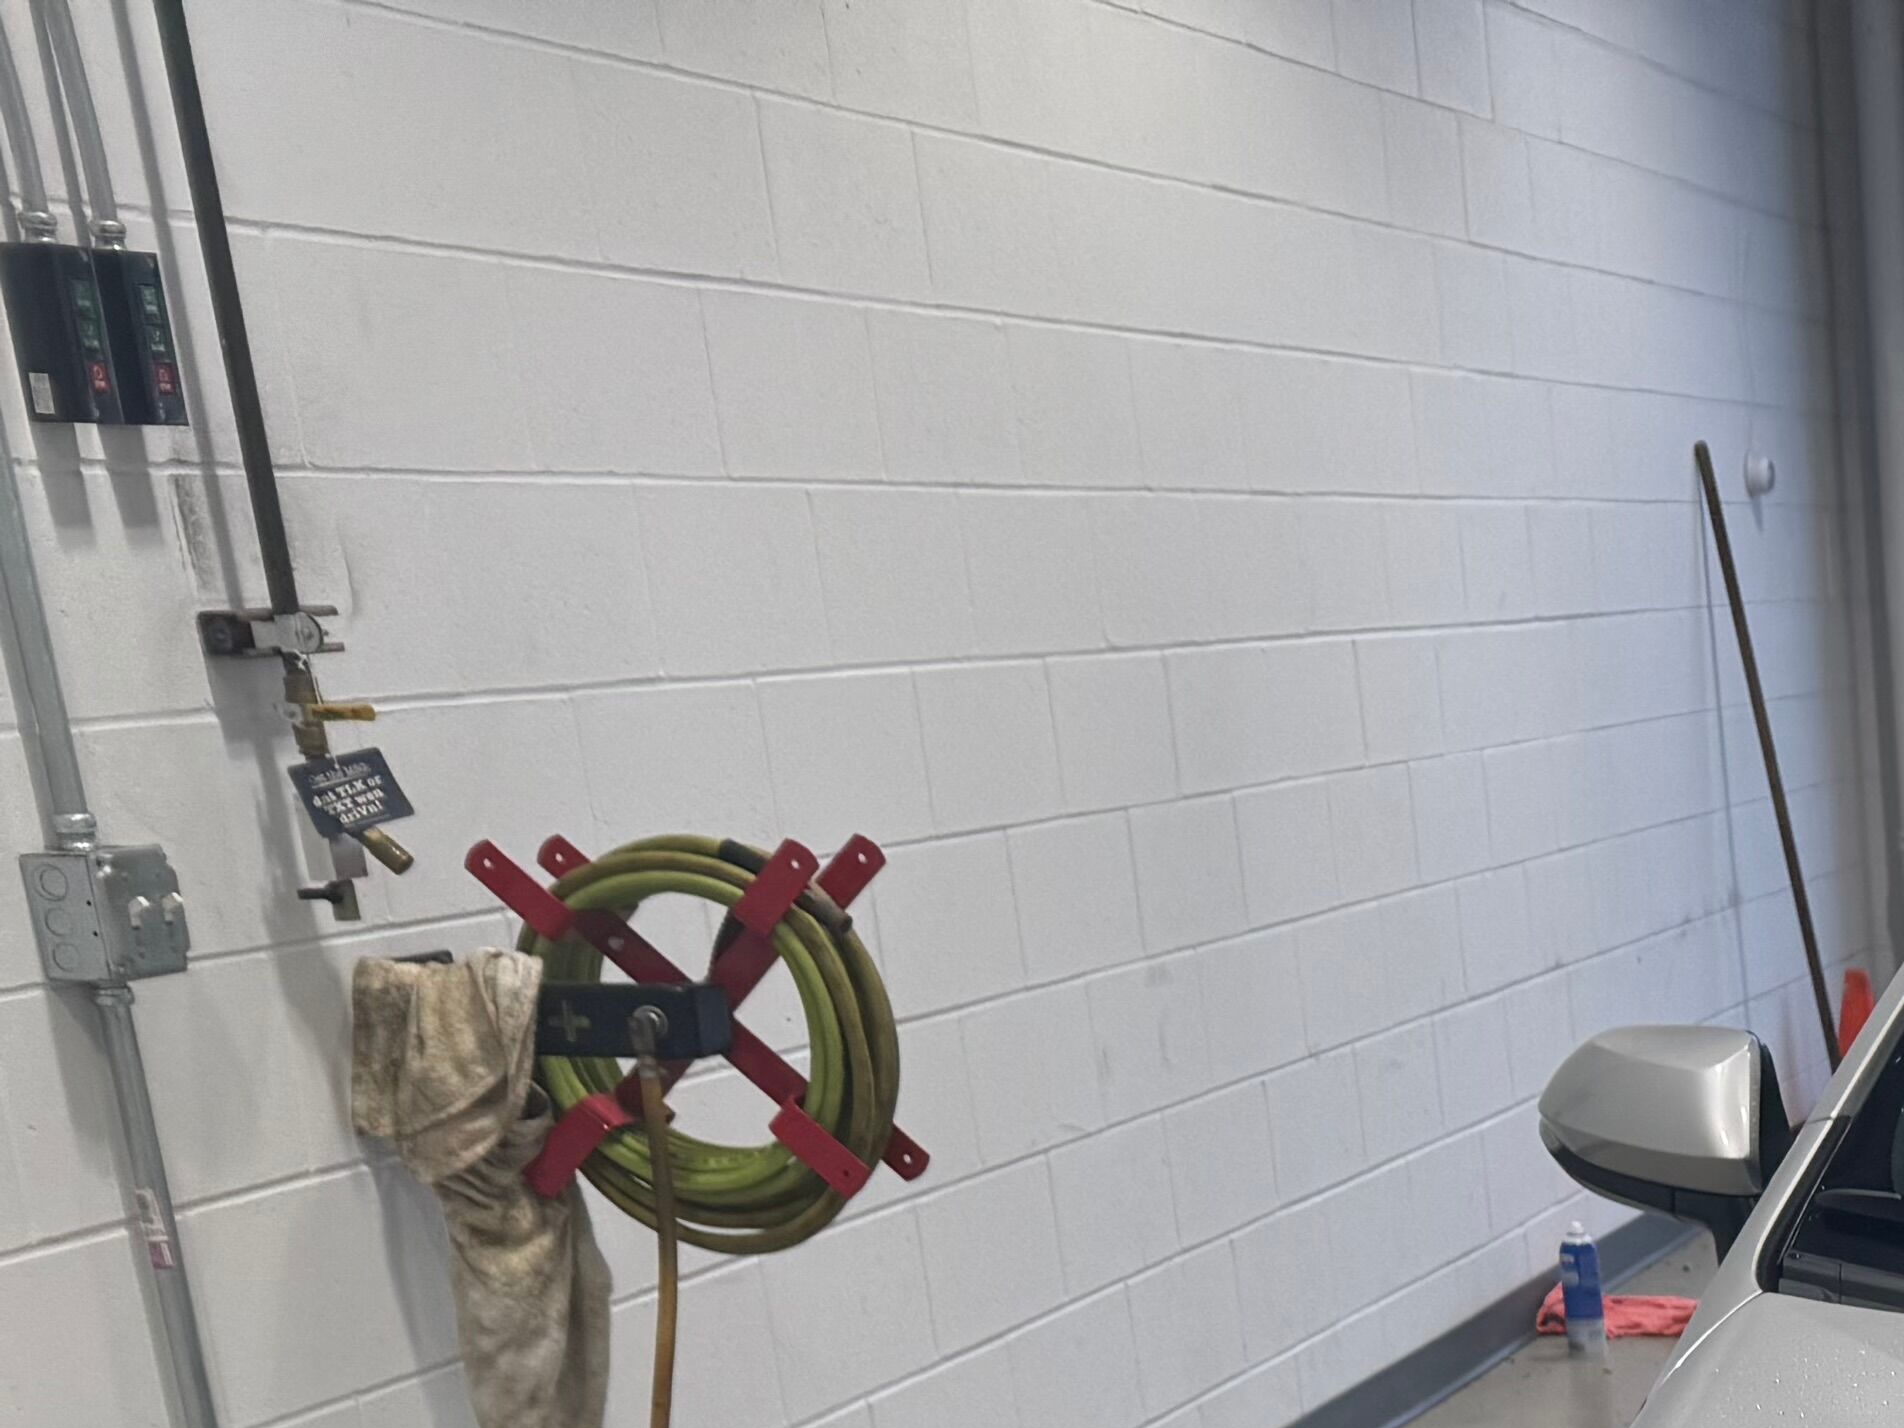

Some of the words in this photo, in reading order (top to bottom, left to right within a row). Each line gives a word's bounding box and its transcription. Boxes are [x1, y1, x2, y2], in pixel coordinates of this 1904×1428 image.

[335, 779, 367, 797] TLK
[324, 798, 353, 815] TXT
[354, 789, 384, 804] wen
